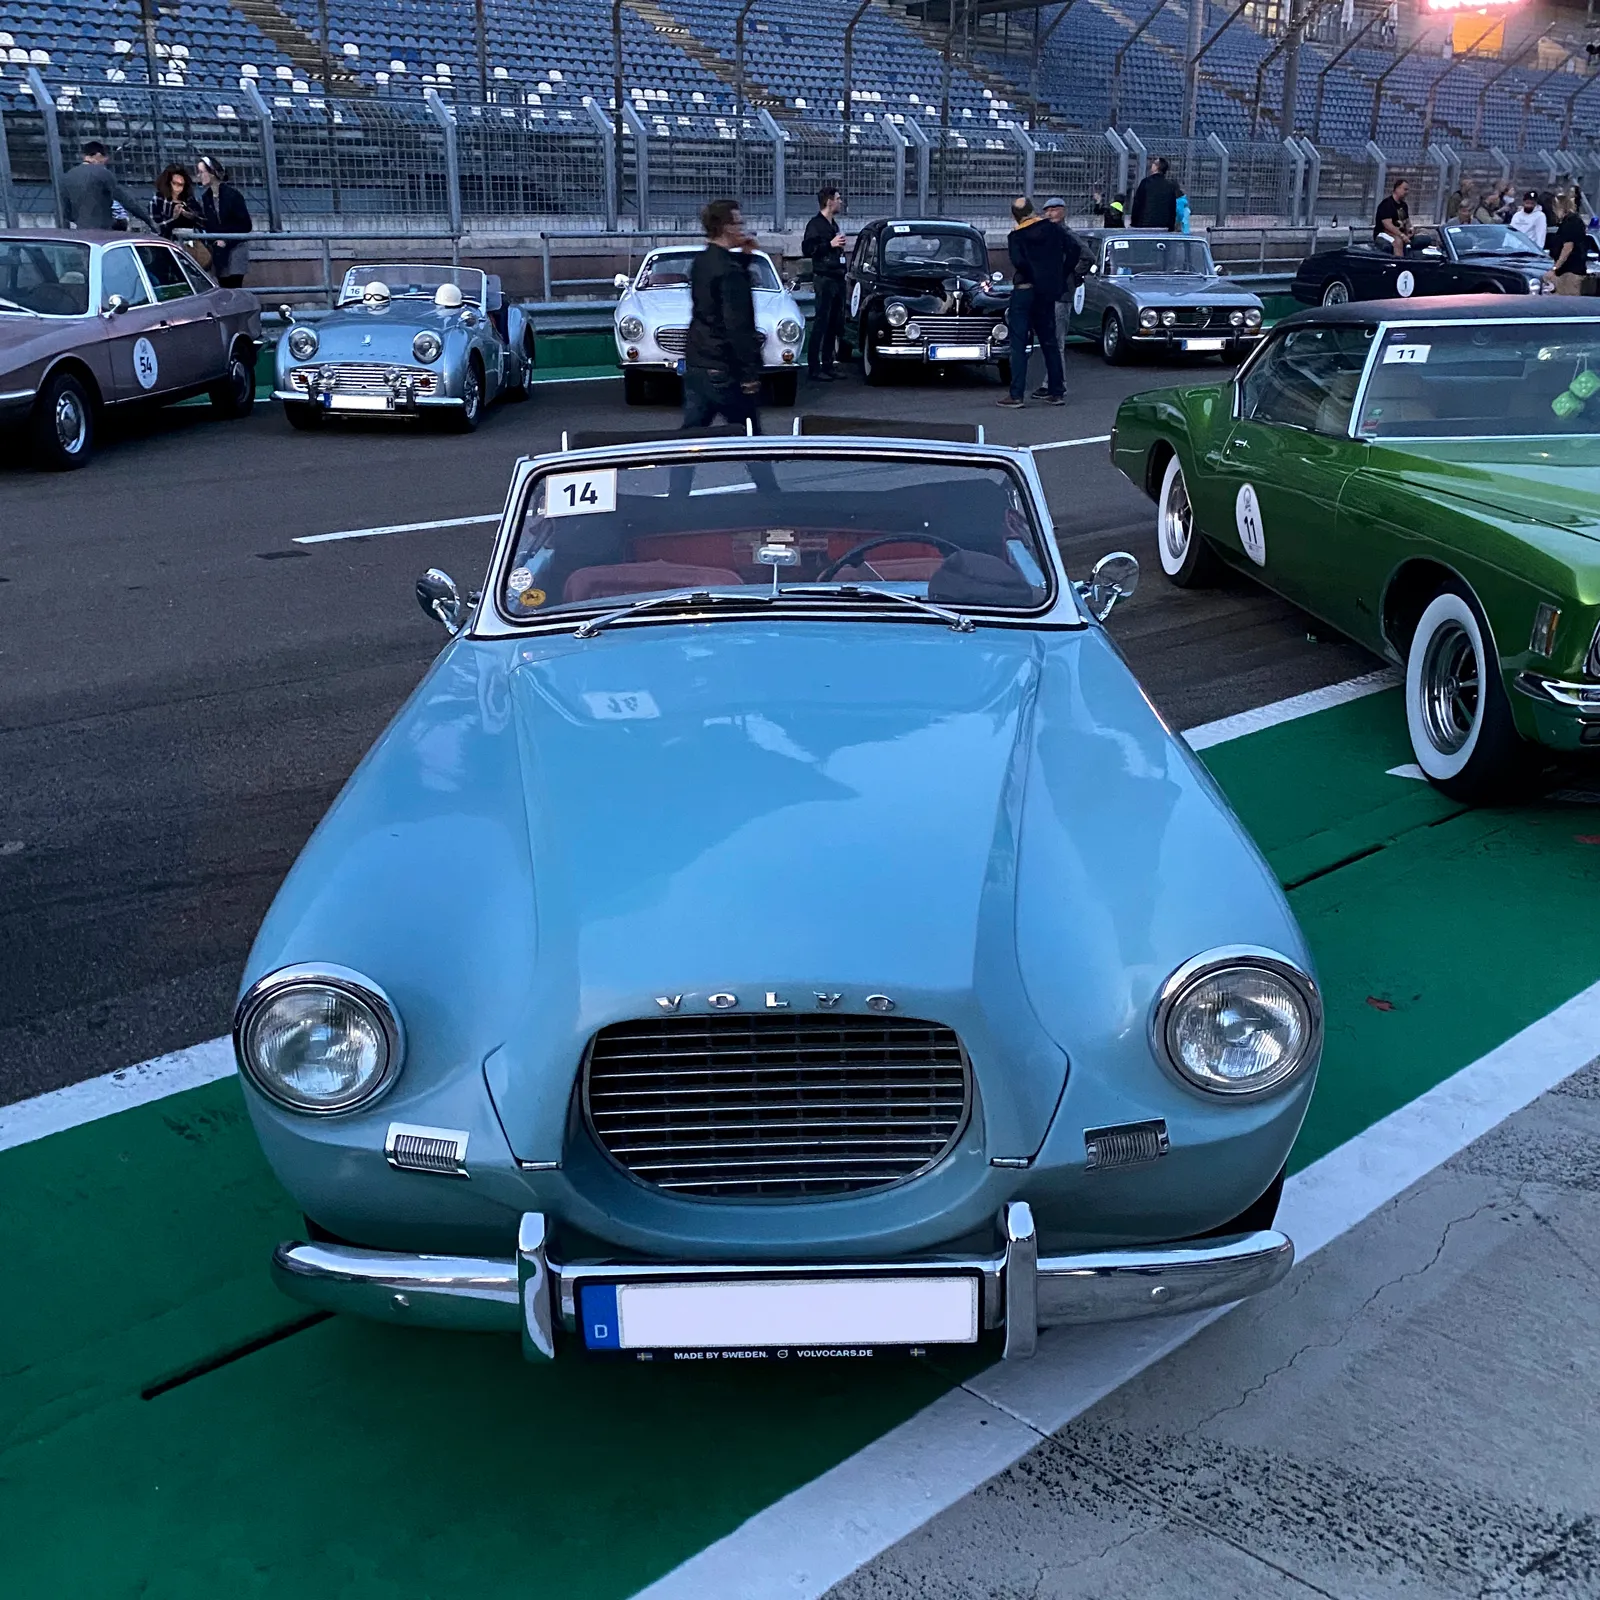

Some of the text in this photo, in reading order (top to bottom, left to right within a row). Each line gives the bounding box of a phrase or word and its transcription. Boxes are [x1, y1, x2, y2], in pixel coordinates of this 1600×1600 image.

[1396, 349, 1416, 359] 11
[140, 356, 152, 373] 54
[386, 396, 394, 408] H
[563, 482, 598, 507] 14
[1244, 516, 1258, 545] 11
[655, 990, 896, 1013] VOLVO
[594, 1324, 608, 1338] D
[673, 1349, 874, 1360] MADE BY SWEDEN. VOLVOCARS.DE
